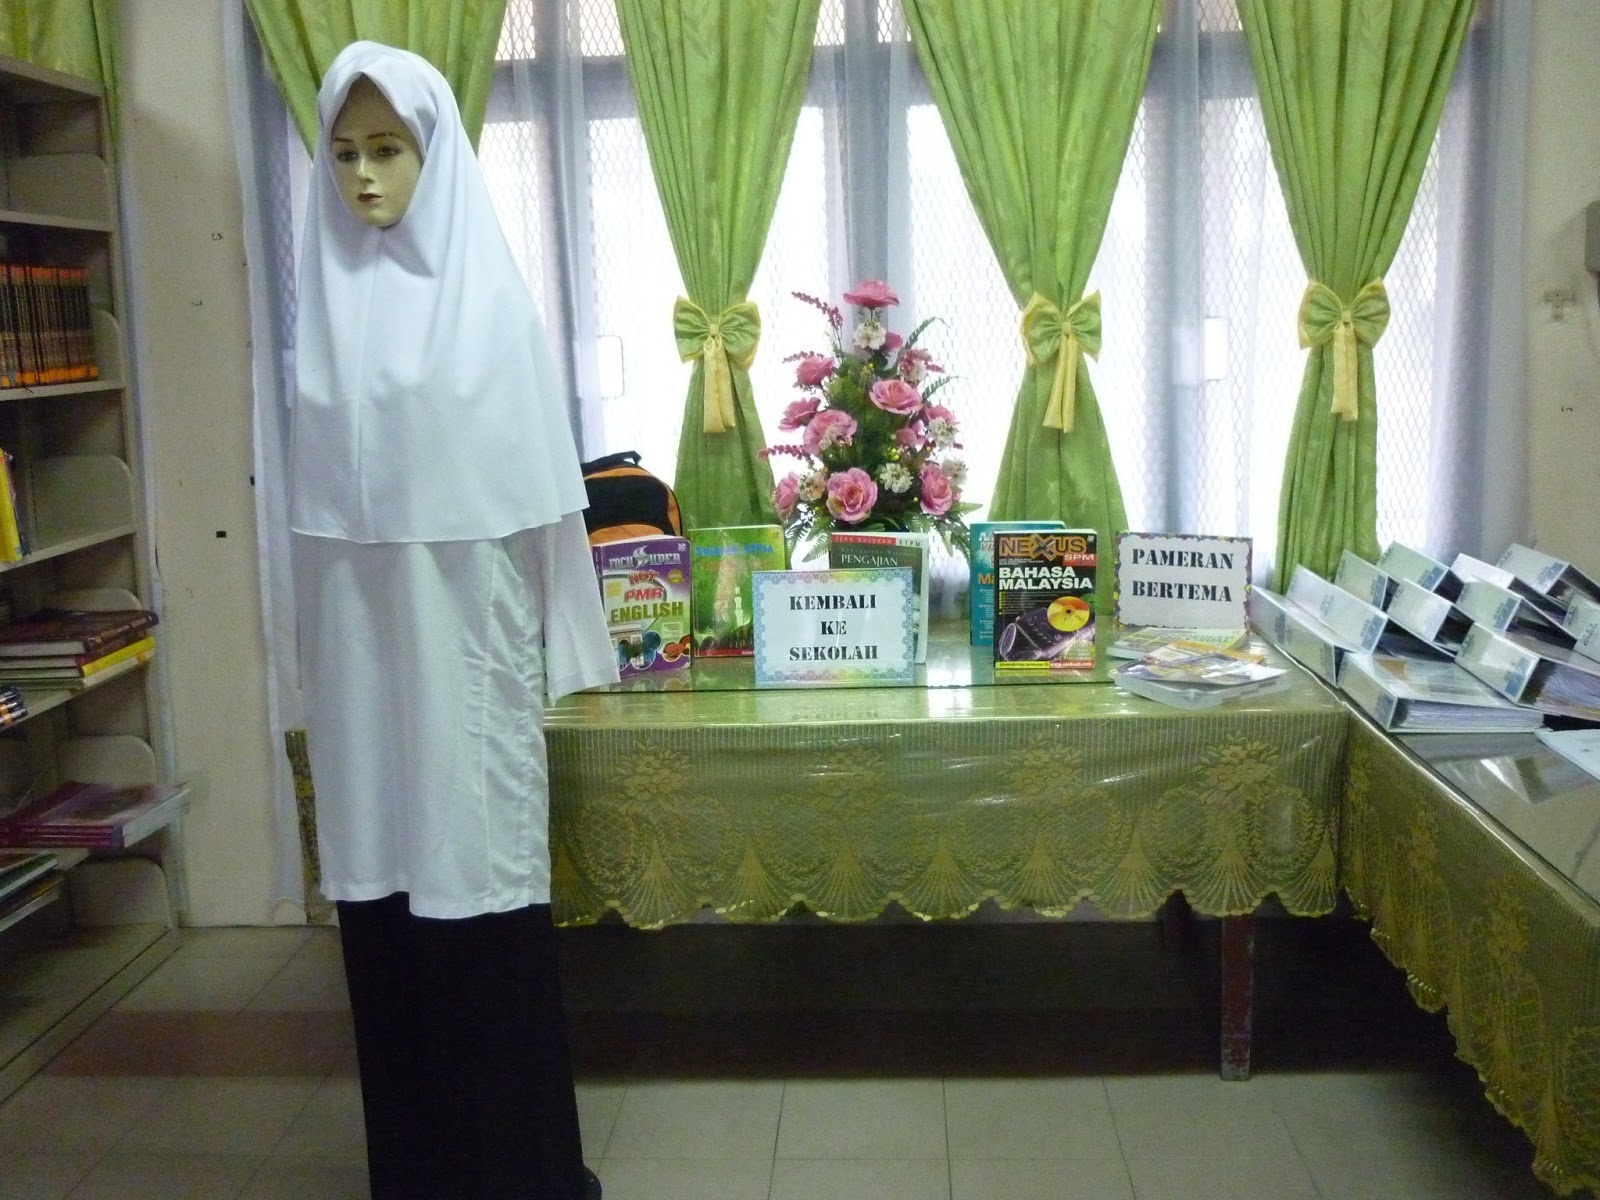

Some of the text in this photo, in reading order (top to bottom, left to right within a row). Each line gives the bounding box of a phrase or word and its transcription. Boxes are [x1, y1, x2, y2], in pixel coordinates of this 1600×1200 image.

[999, 534, 1088, 560] NEXUS
[841, 553, 898, 567] PENGAJIAN
[1064, 553, 1096, 561] SPM
[1132, 548, 1234, 570] PAMERAN
[628, 569, 659, 585] HOT
[998, 566, 1076, 579] BAHASA
[998, 578, 1093, 590] MALAYSIA
[1132, 580, 1233, 602] BERTEMA
[623, 587, 665, 603] PMR
[789, 594, 877, 611] KEMBALI
[610, 601, 684, 624] ENGLISH
[820, 620, 848, 636] KE
[789, 645, 879, 661] SEKOLAH
